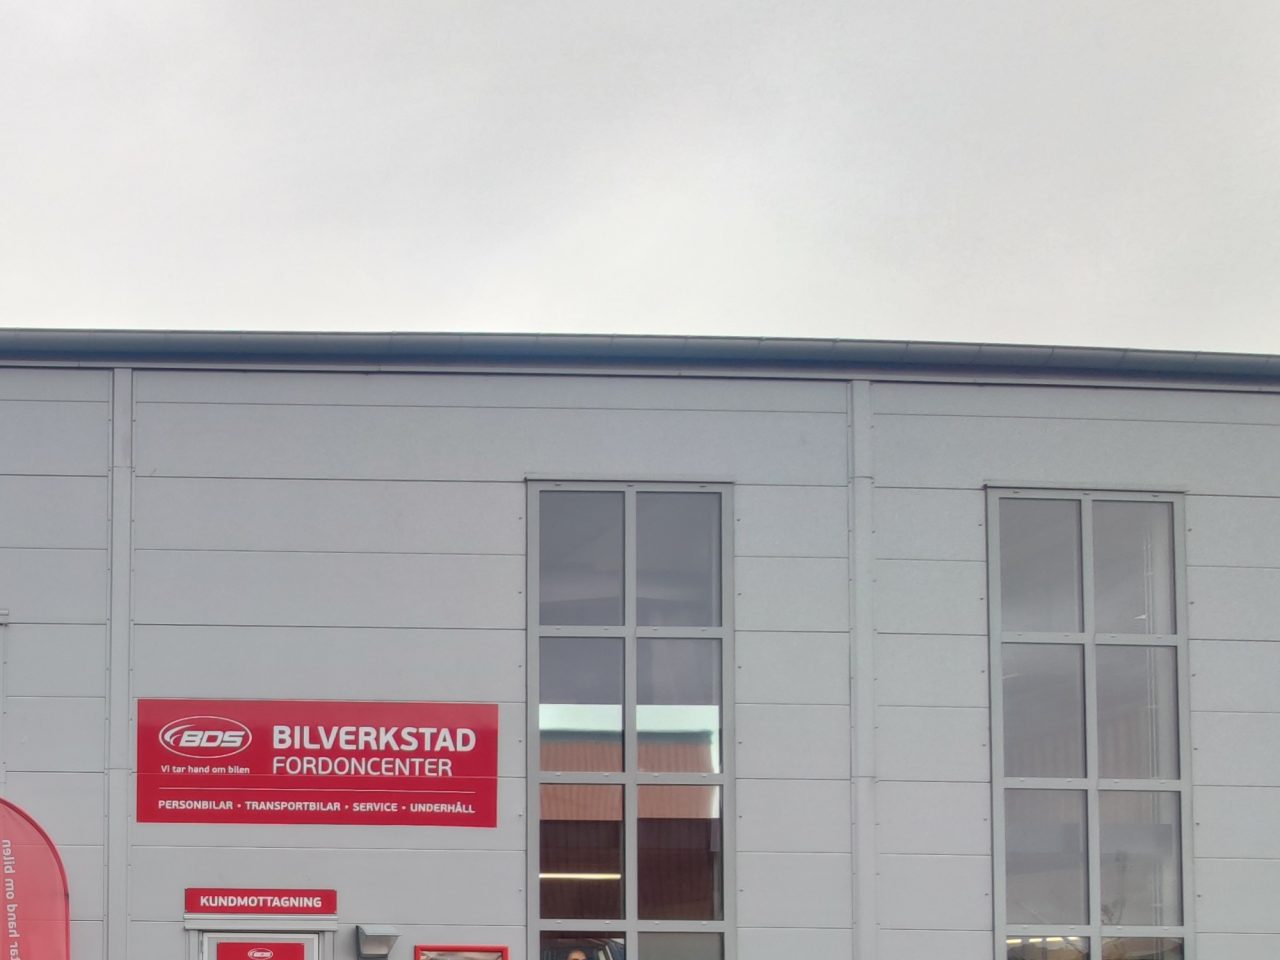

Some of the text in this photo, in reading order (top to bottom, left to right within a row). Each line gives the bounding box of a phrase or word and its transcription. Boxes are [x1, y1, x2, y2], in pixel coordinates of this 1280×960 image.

[178, 729, 246, 748] BDS
[272, 725, 477, 752] BILVERKSTAD
[161, 765, 250, 774] Vi tar hand om bilen
[272, 756, 453, 777] FORDONCENTER
[158, 800, 476, 814] PERSONBILAR TRANSPORTBILAR SERVICE UNDERHÅLL
[200, 895, 322, 908] KUNDMOTTAGNING
